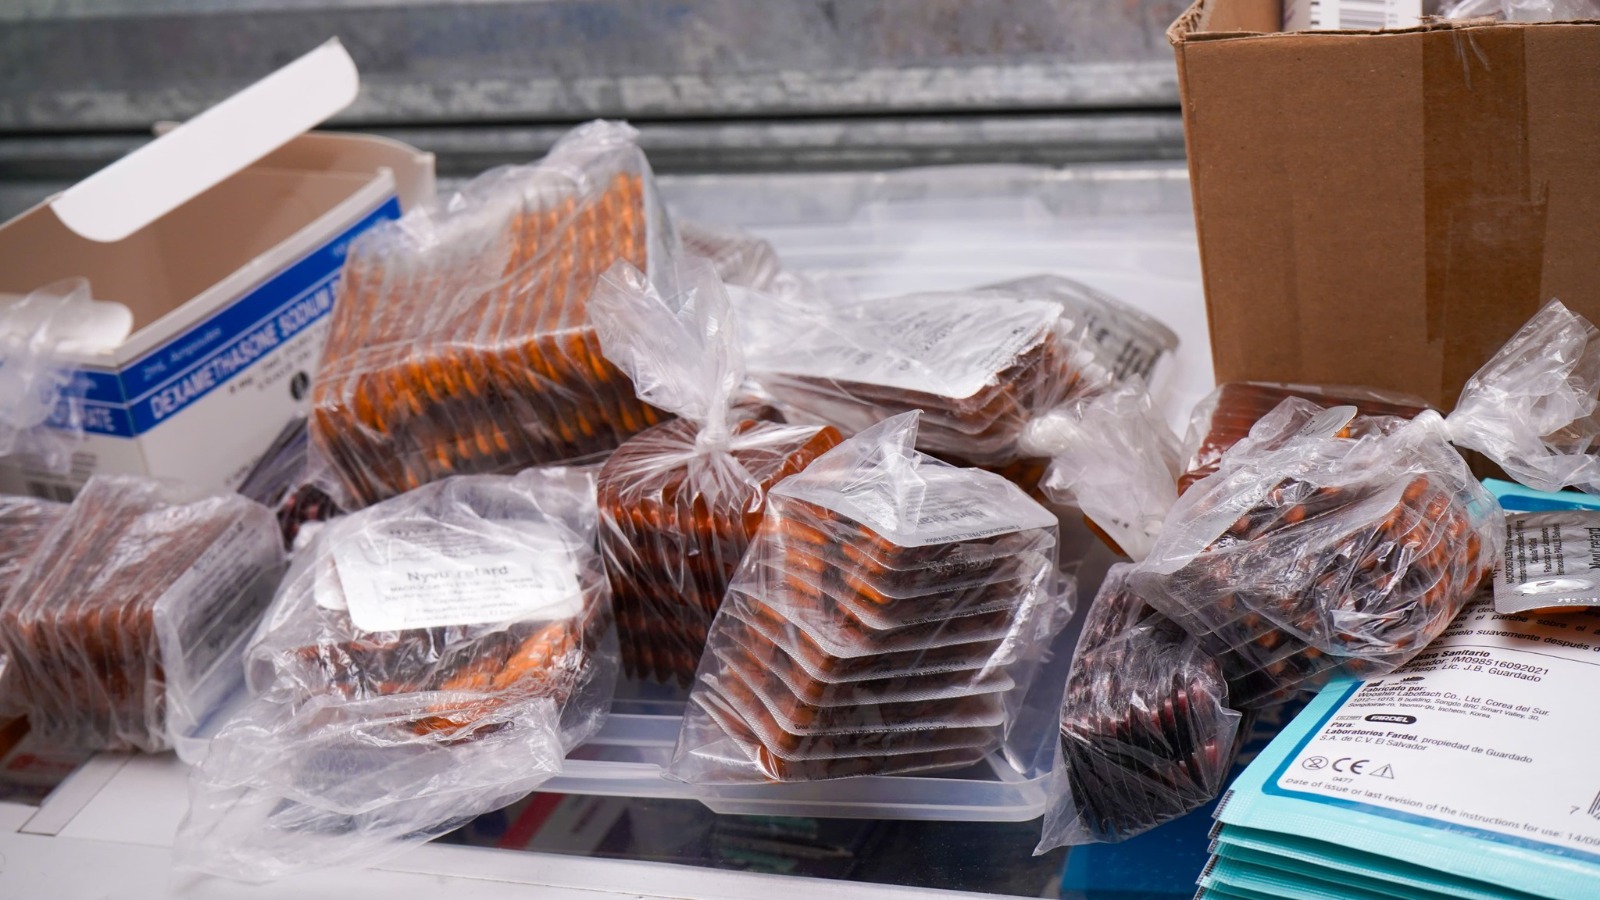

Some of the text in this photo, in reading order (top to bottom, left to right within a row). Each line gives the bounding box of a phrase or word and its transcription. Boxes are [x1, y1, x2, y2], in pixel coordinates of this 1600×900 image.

[150, 321, 282, 420] DEXAMETHASONE
[279, 290, 331, 338] SODIUM
[1491, 612, 1529, 623] parche
[1536, 618, 1567, 629] sobre
[1575, 624, 1587, 632] el
[1476, 628, 1541, 642] suavemente
[1543, 636, 1590, 651] después
[1440, 649, 1491, 658] Sanitario
[1401, 656, 1550, 676] Salvador: IM098516092021
[1410, 665, 1437, 674] Resp.
[1442, 663, 1460, 671] Lic.
[1463, 664, 1485, 673] J.B.
[1488, 667, 1542, 683] Guardado
[1362, 685, 1407, 693] Fabricado
[1358, 690, 1396, 698] Wooshin
[1443, 691, 1462, 701] Co.,
[1464, 695, 1483, 704] Ltd.
[1485, 698, 1514, 710] Corea
[1515, 704, 1531, 713] del
[1532, 707, 1551, 717] Sur.
[1434, 698, 1462, 708] Songdo
[1462, 702, 1480, 710] BRC
[1480, 704, 1503, 715] Smart
[1370, 715, 1409, 723] FARDEL
[1469, 709, 1491, 719] Korea.
[1325, 728, 1533, 764] Laboratorios Fardel, propiedad de Guardado
[1354, 736, 1373, 744] C.V.
[1386, 739, 1428, 751] Salvador
[1332, 776, 1354, 784] 0477
[1285, 777, 1309, 786] Date
[1311, 780, 1323, 788] of
[1324, 783, 1349, 793] issue
[1351, 788, 1363, 796] or
[1364, 789, 1383, 800] last
[1384, 793, 1424, 808] revision
[1426, 802, 1438, 811] of
[1439, 804, 1458, 816] the
[1459, 809, 1520, 829] instructions
[1522, 823, 1540, 833] for
[1541, 828, 1564, 837] use:
